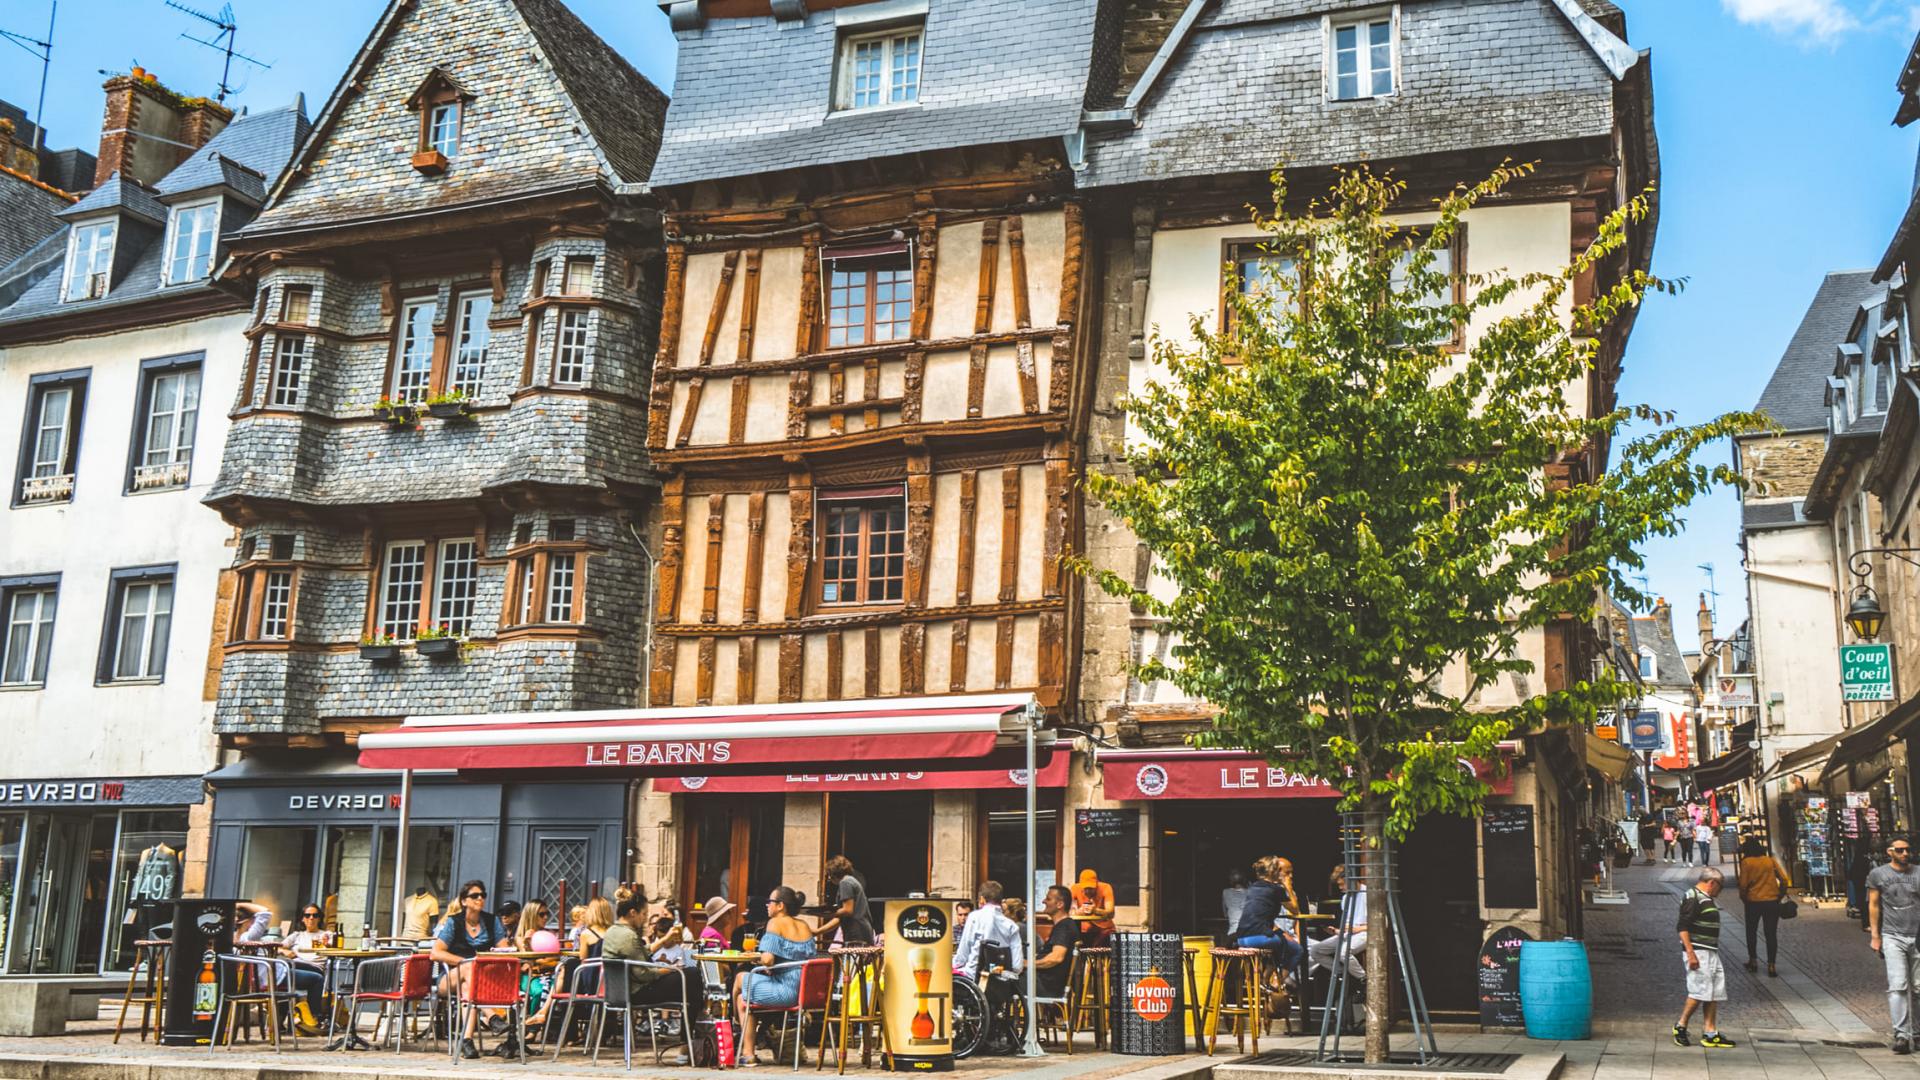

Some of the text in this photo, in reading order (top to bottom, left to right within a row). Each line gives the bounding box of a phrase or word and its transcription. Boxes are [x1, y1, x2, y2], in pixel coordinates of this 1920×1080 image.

[1845, 650, 1885, 664] Coup
[1846, 692, 1880, 700] PORTER
[586, 741, 731, 765] LE BARN'S
[1220, 767, 1260, 788] LE
[101, 783, 124, 800] 1902
[1152, 933, 1180, 941] CUBA
[1127, 983, 1176, 998] Havana
[1137, 999, 1168, 1013] Club
